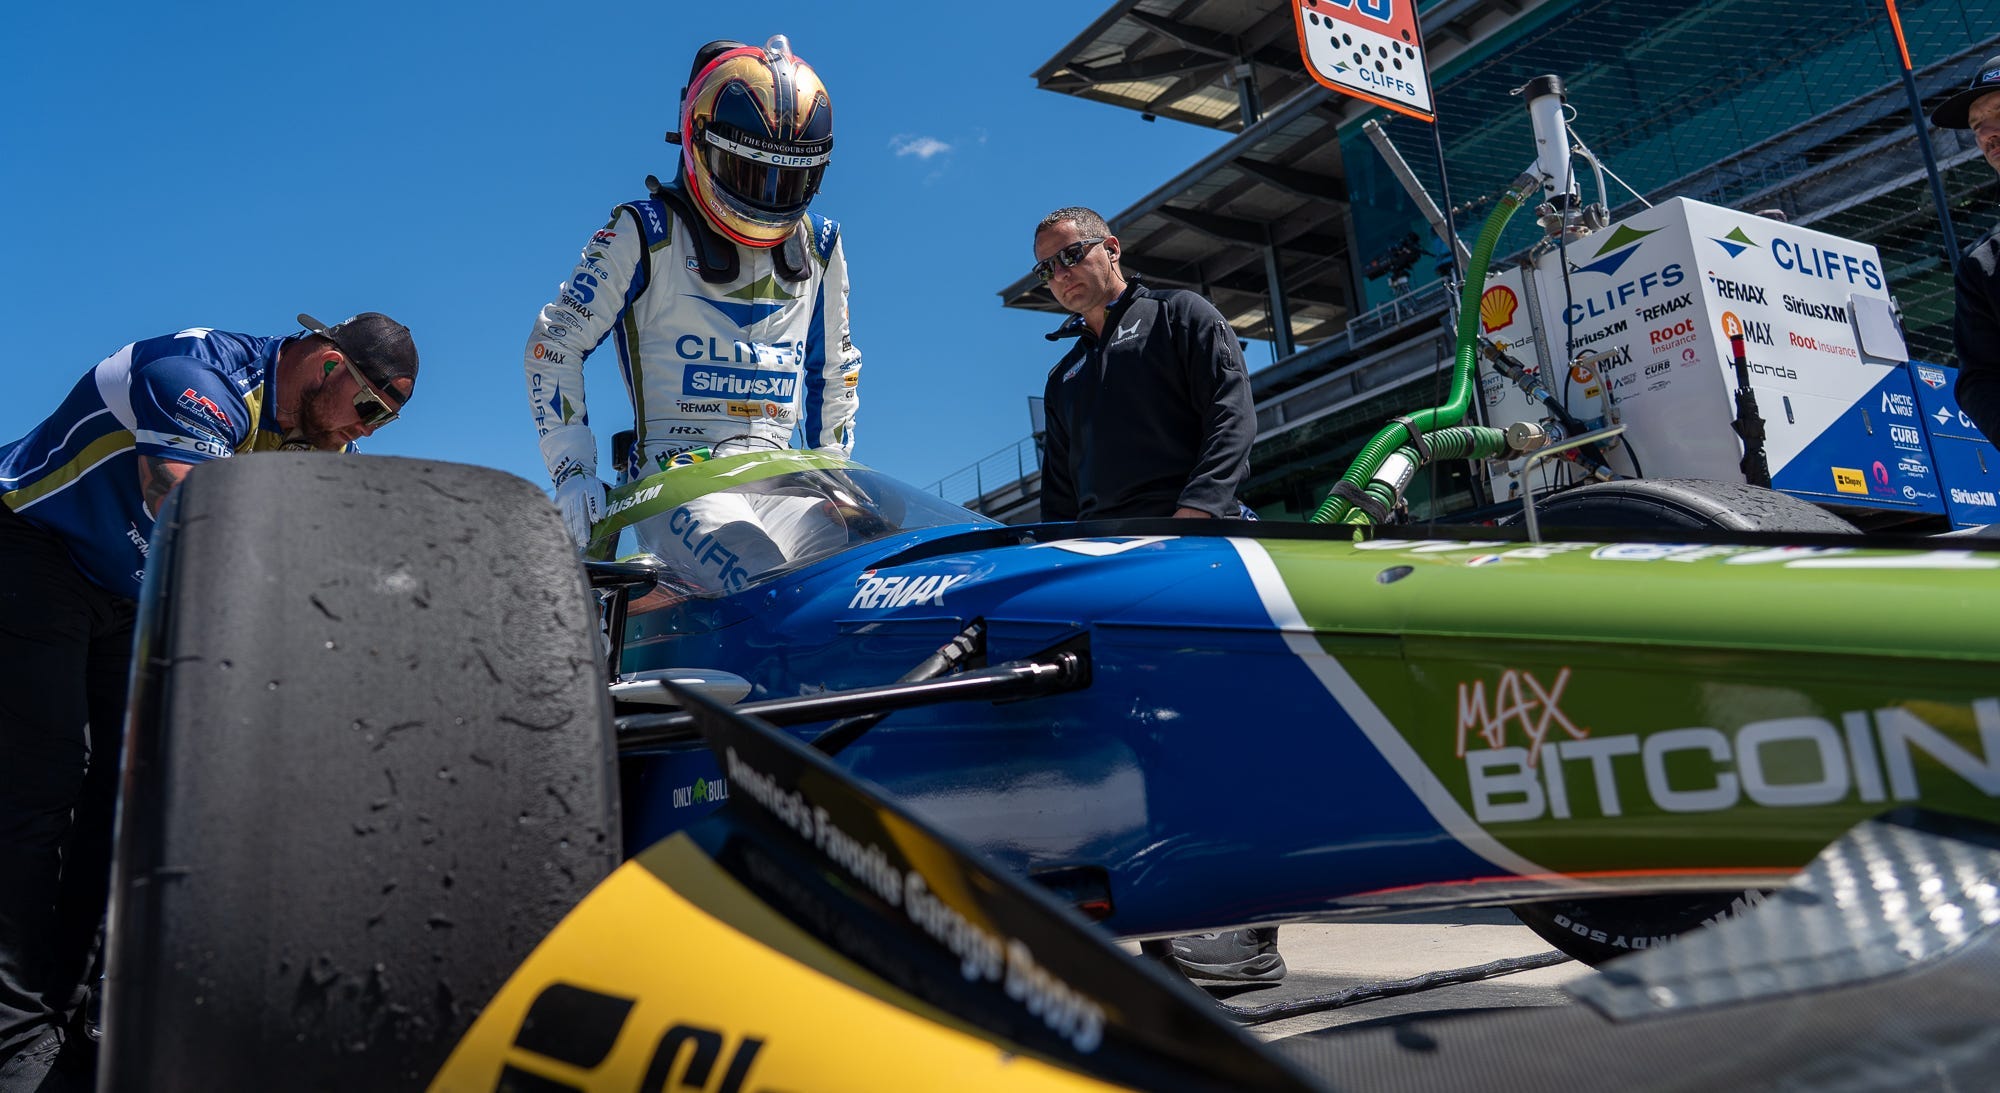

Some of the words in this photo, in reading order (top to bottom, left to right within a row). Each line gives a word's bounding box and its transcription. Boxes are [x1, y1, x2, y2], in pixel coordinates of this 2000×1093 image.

[1359, 68, 1416, 96] CLIFFS
[743, 136, 760, 147] THE
[761, 141, 805, 154] CONCOURS
[771, 155, 813, 166] CLIFFS
[580, 261, 609, 280] LIFFS
[1771, 238, 1882, 290] CLIFFS
[1562, 264, 1685, 326] CLIFFS
[1716, 278, 1768, 306] REMAX
[1643, 293, 1693, 322] REMAX
[1783, 295, 1847, 324] SiriusXM
[1565, 320, 1628, 351] SiriusXM
[1649, 318, 1695, 345] Root
[1742, 319, 1774, 346] MAX
[1789, 332, 1818, 351] Root
[543, 349, 566, 364] MAX
[1598, 344, 1633, 373] MAX
[1645, 360, 1671, 376] CURB
[691, 371, 795, 397] SiriusXM
[680, 403, 721, 413] REMAX
[1890, 393, 1913, 406] ARCTIC
[1894, 404, 1913, 417] WOLF
[669, 426, 707, 435] HRX
[1890, 427, 1920, 444] CURB
[194, 441, 232, 457] CLIF
[655, 445, 699, 463] HEL
[606, 483, 664, 518] iusXM
[1950, 488, 1997, 507] SiriusXM
[669, 506, 749, 597] CLIFFS
[849, 574, 967, 609] REMAX
[1456, 667, 1590, 768] MAX
[1465, 698, 2000, 824] BITCOIN
[673, 785, 692, 809] ONLY
[1553, 913, 1608, 945] 500
